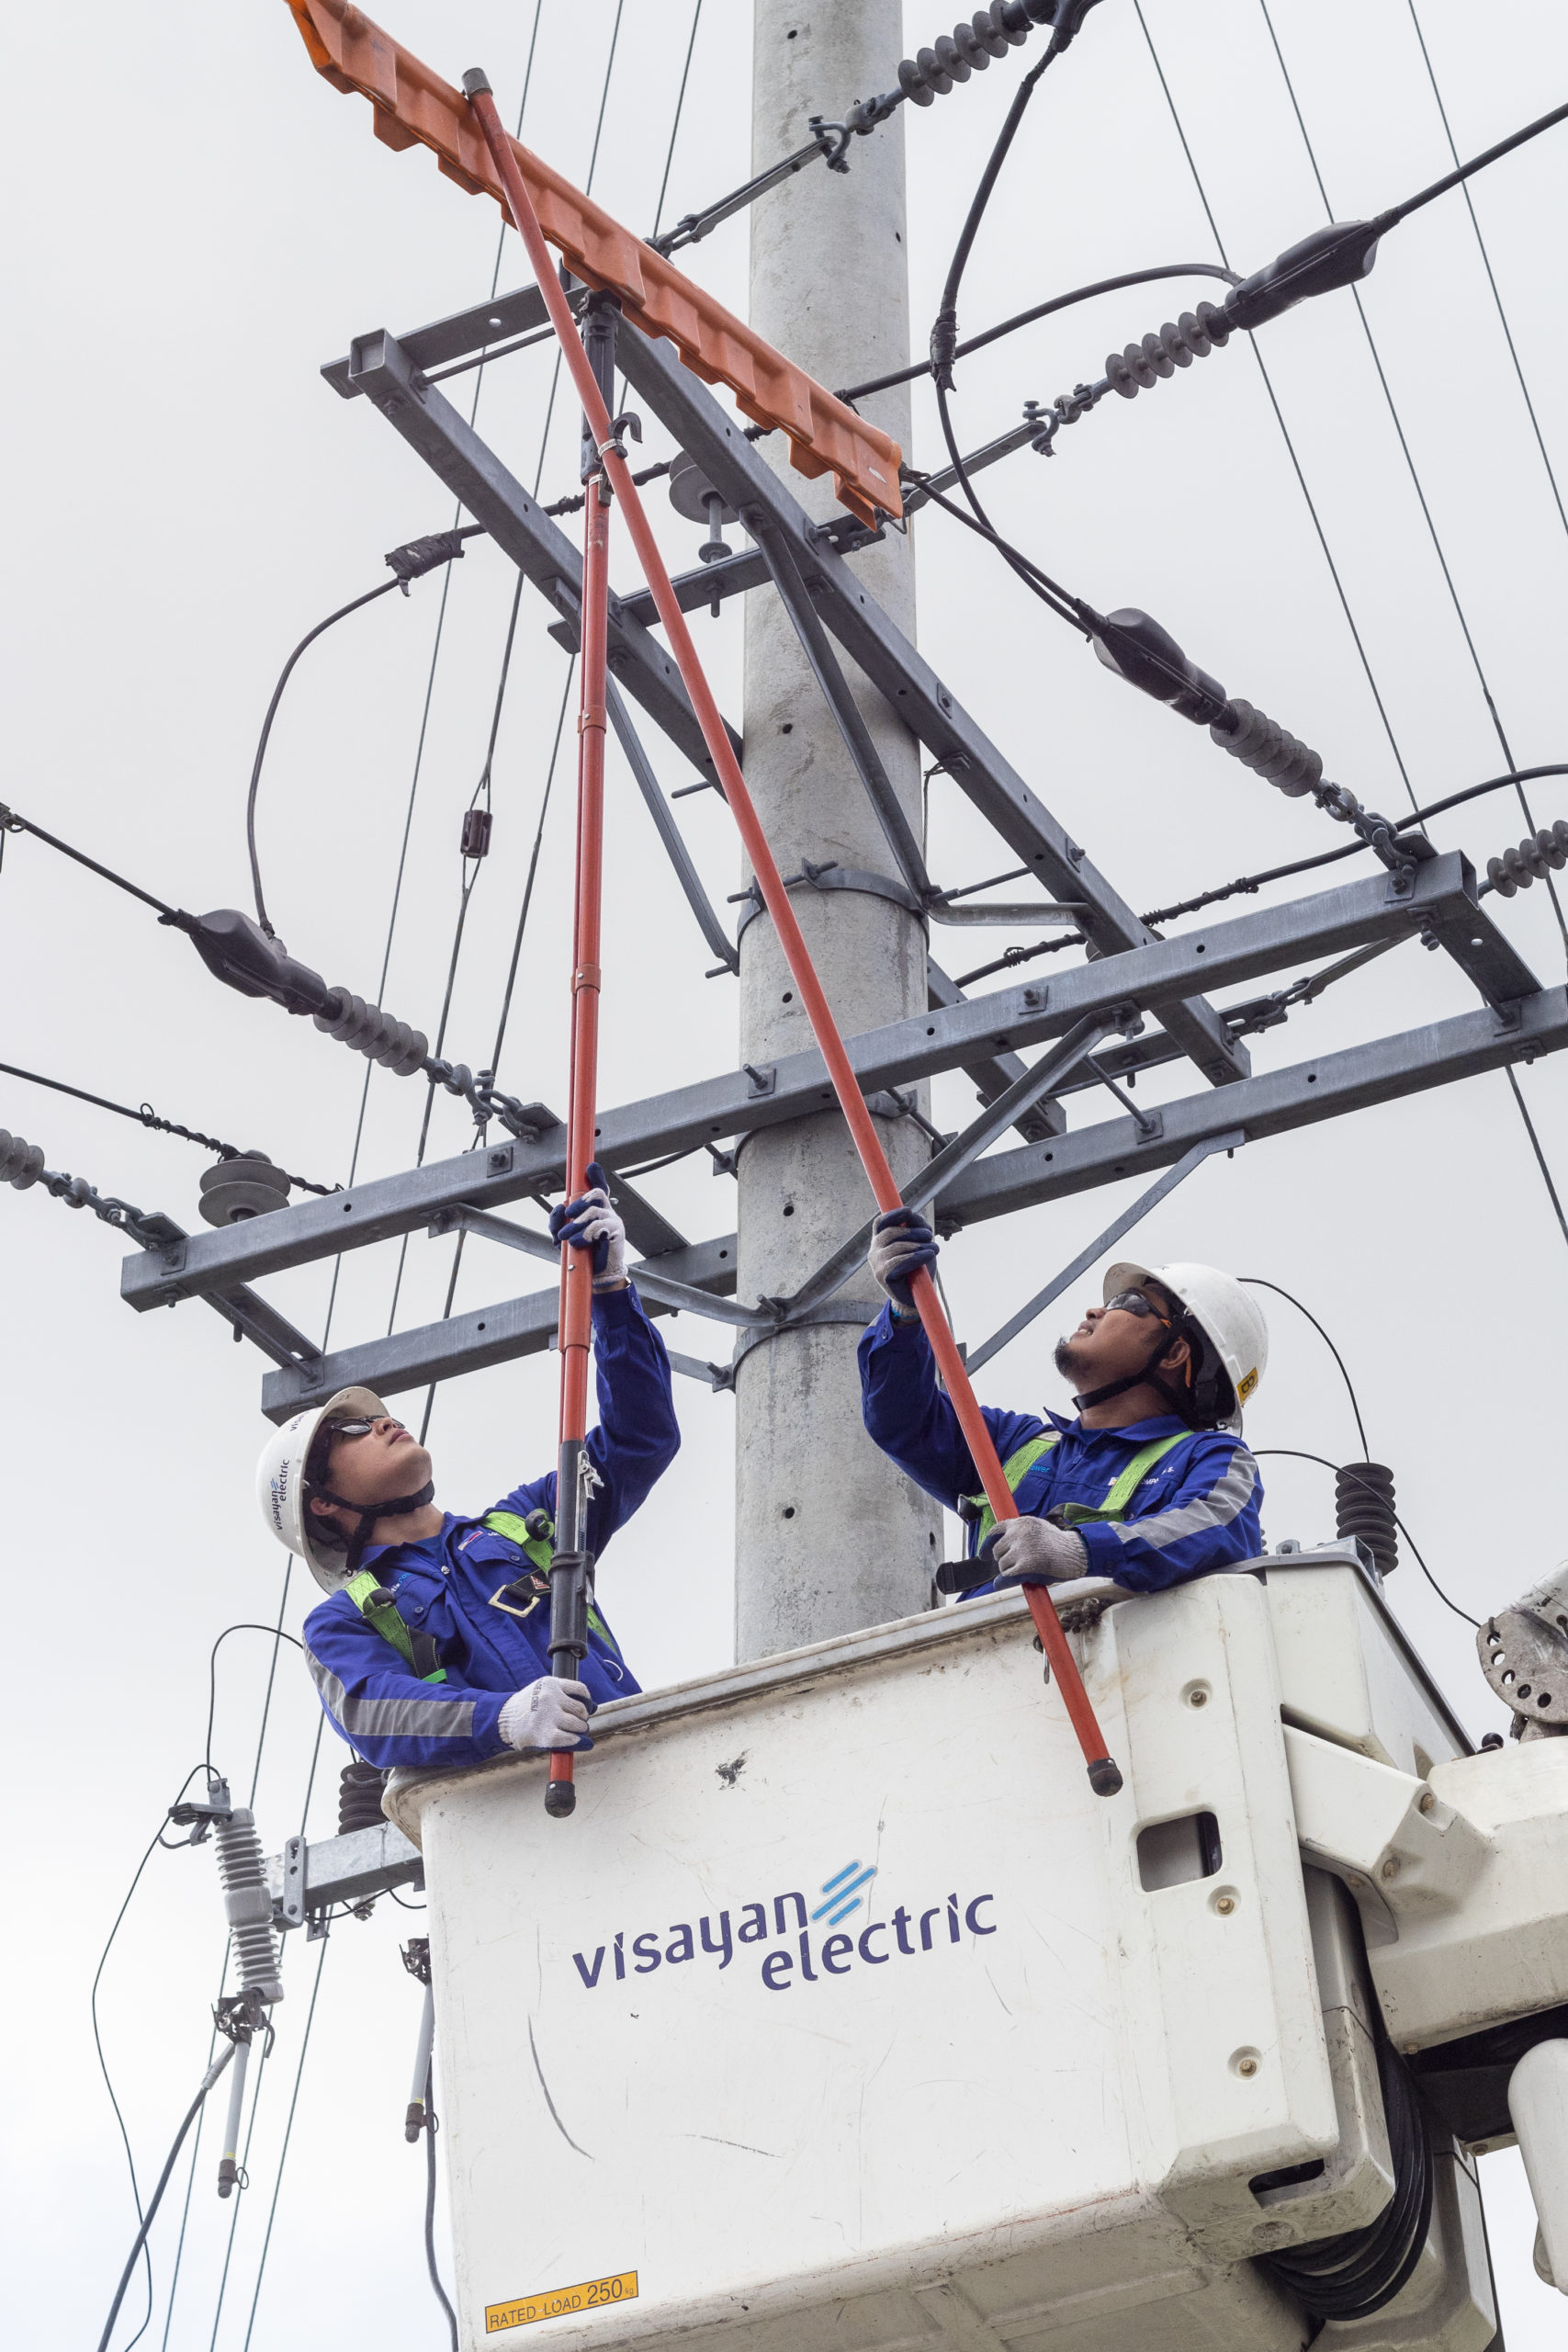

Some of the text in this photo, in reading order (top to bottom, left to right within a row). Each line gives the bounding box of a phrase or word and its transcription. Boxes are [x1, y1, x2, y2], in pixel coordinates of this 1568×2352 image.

[278, 1459, 290, 1501] electric
[271, 1490, 283, 1531] visayan
[572, 1892, 808, 1989] visayan
[761, 1894, 998, 1991] electric
[490, 2306, 536, 2328] RATED
[544, 2295, 581, 2315] LOAD
[587, 2278, 623, 2305] 250
